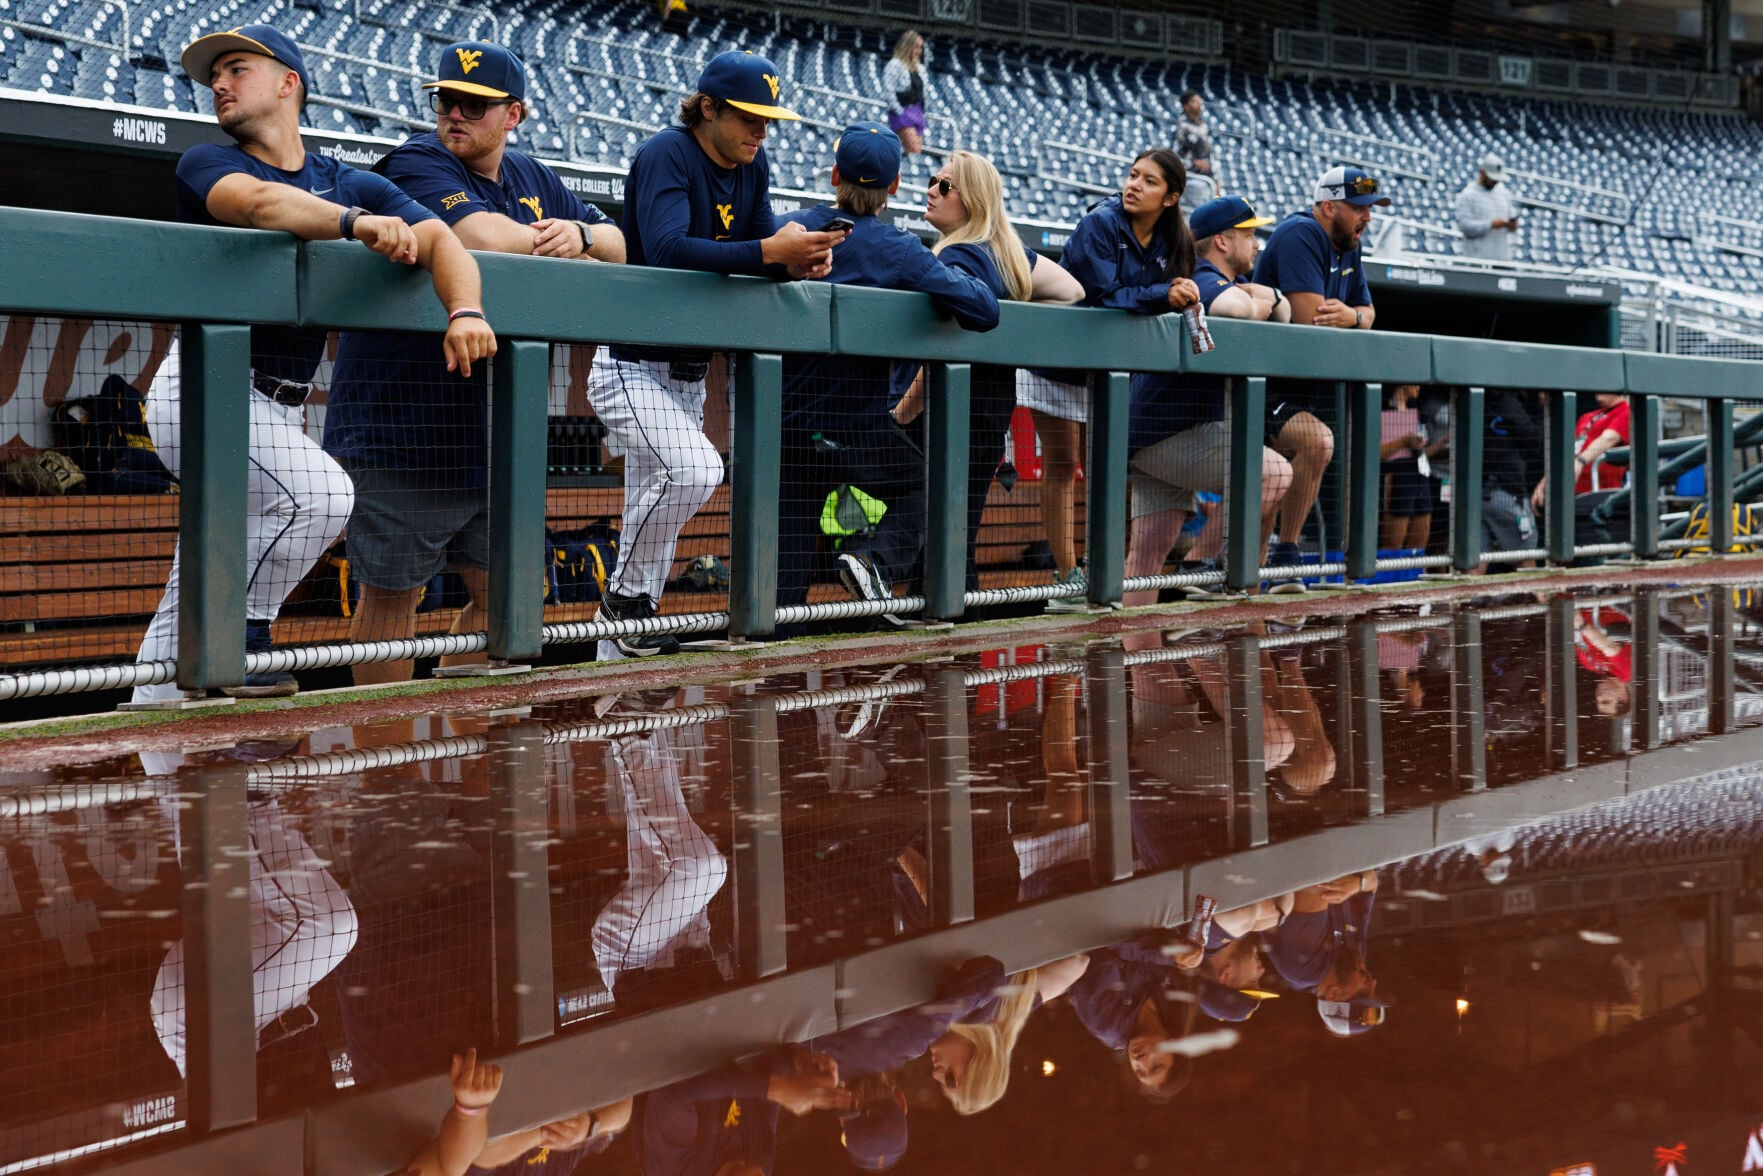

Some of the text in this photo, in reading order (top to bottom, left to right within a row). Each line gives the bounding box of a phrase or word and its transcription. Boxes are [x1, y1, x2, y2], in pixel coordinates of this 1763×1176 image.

[113, 118, 166, 144] #MCWS
[333, 143, 374, 165] Greatest
[582, 179, 610, 194] COLLEGE
